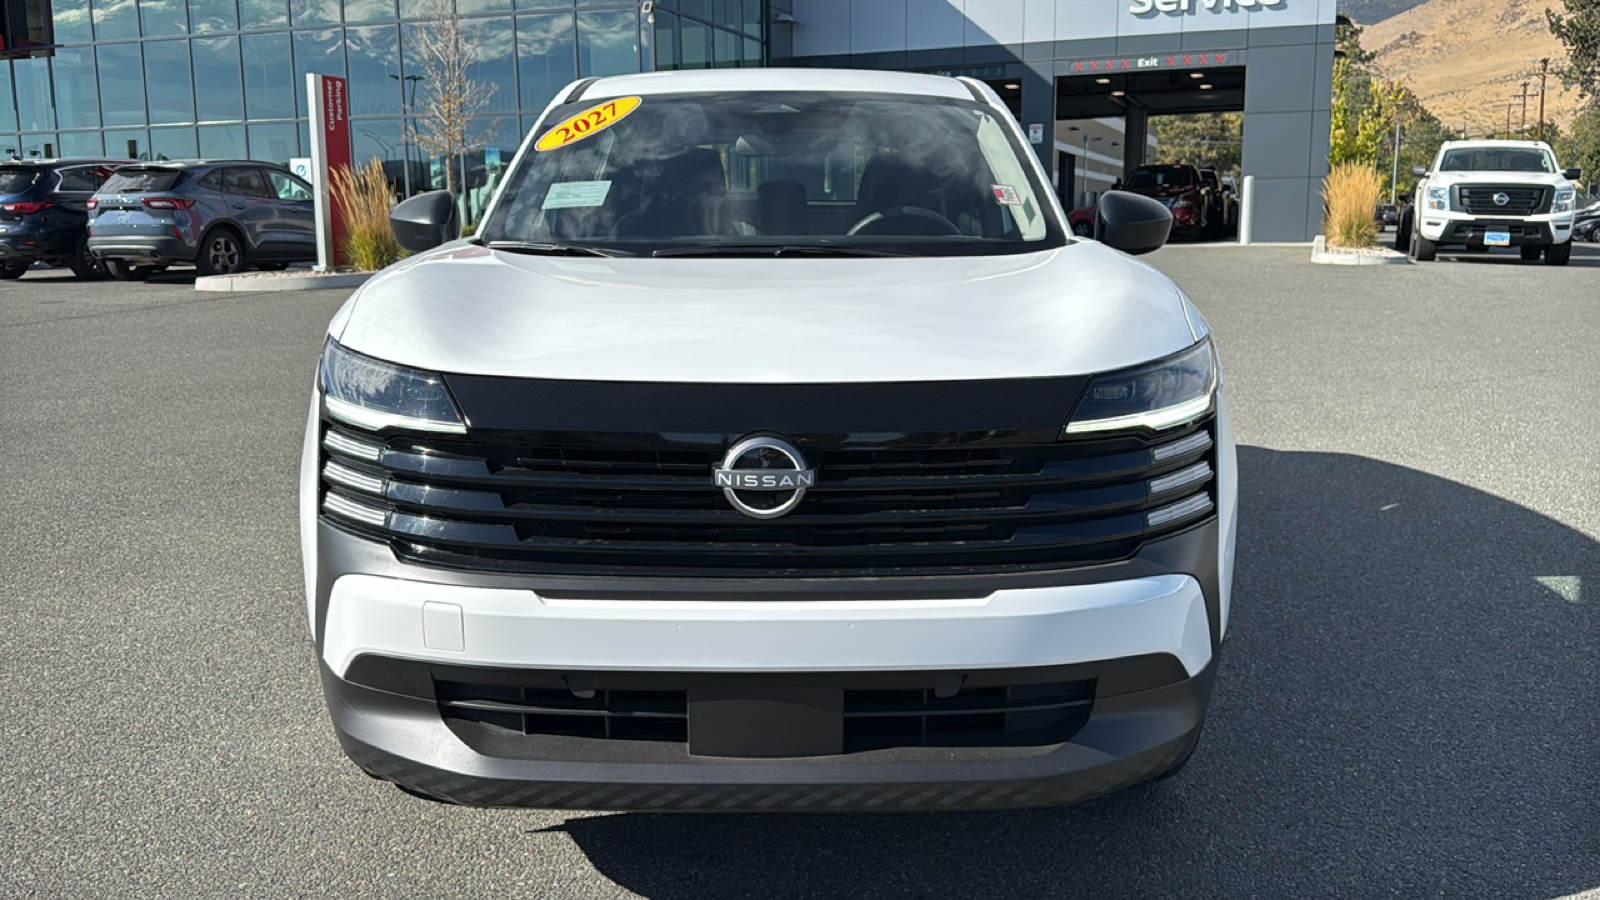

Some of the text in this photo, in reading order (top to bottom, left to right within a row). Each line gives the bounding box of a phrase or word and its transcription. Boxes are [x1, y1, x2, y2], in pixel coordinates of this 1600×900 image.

[1129, 0, 1281, 14] Serv
[1137, 57, 1158, 68] Exit
[327, 80, 335, 131] Customer
[555, 101, 616, 143] 2027
[718, 473, 811, 487] NISSAN
